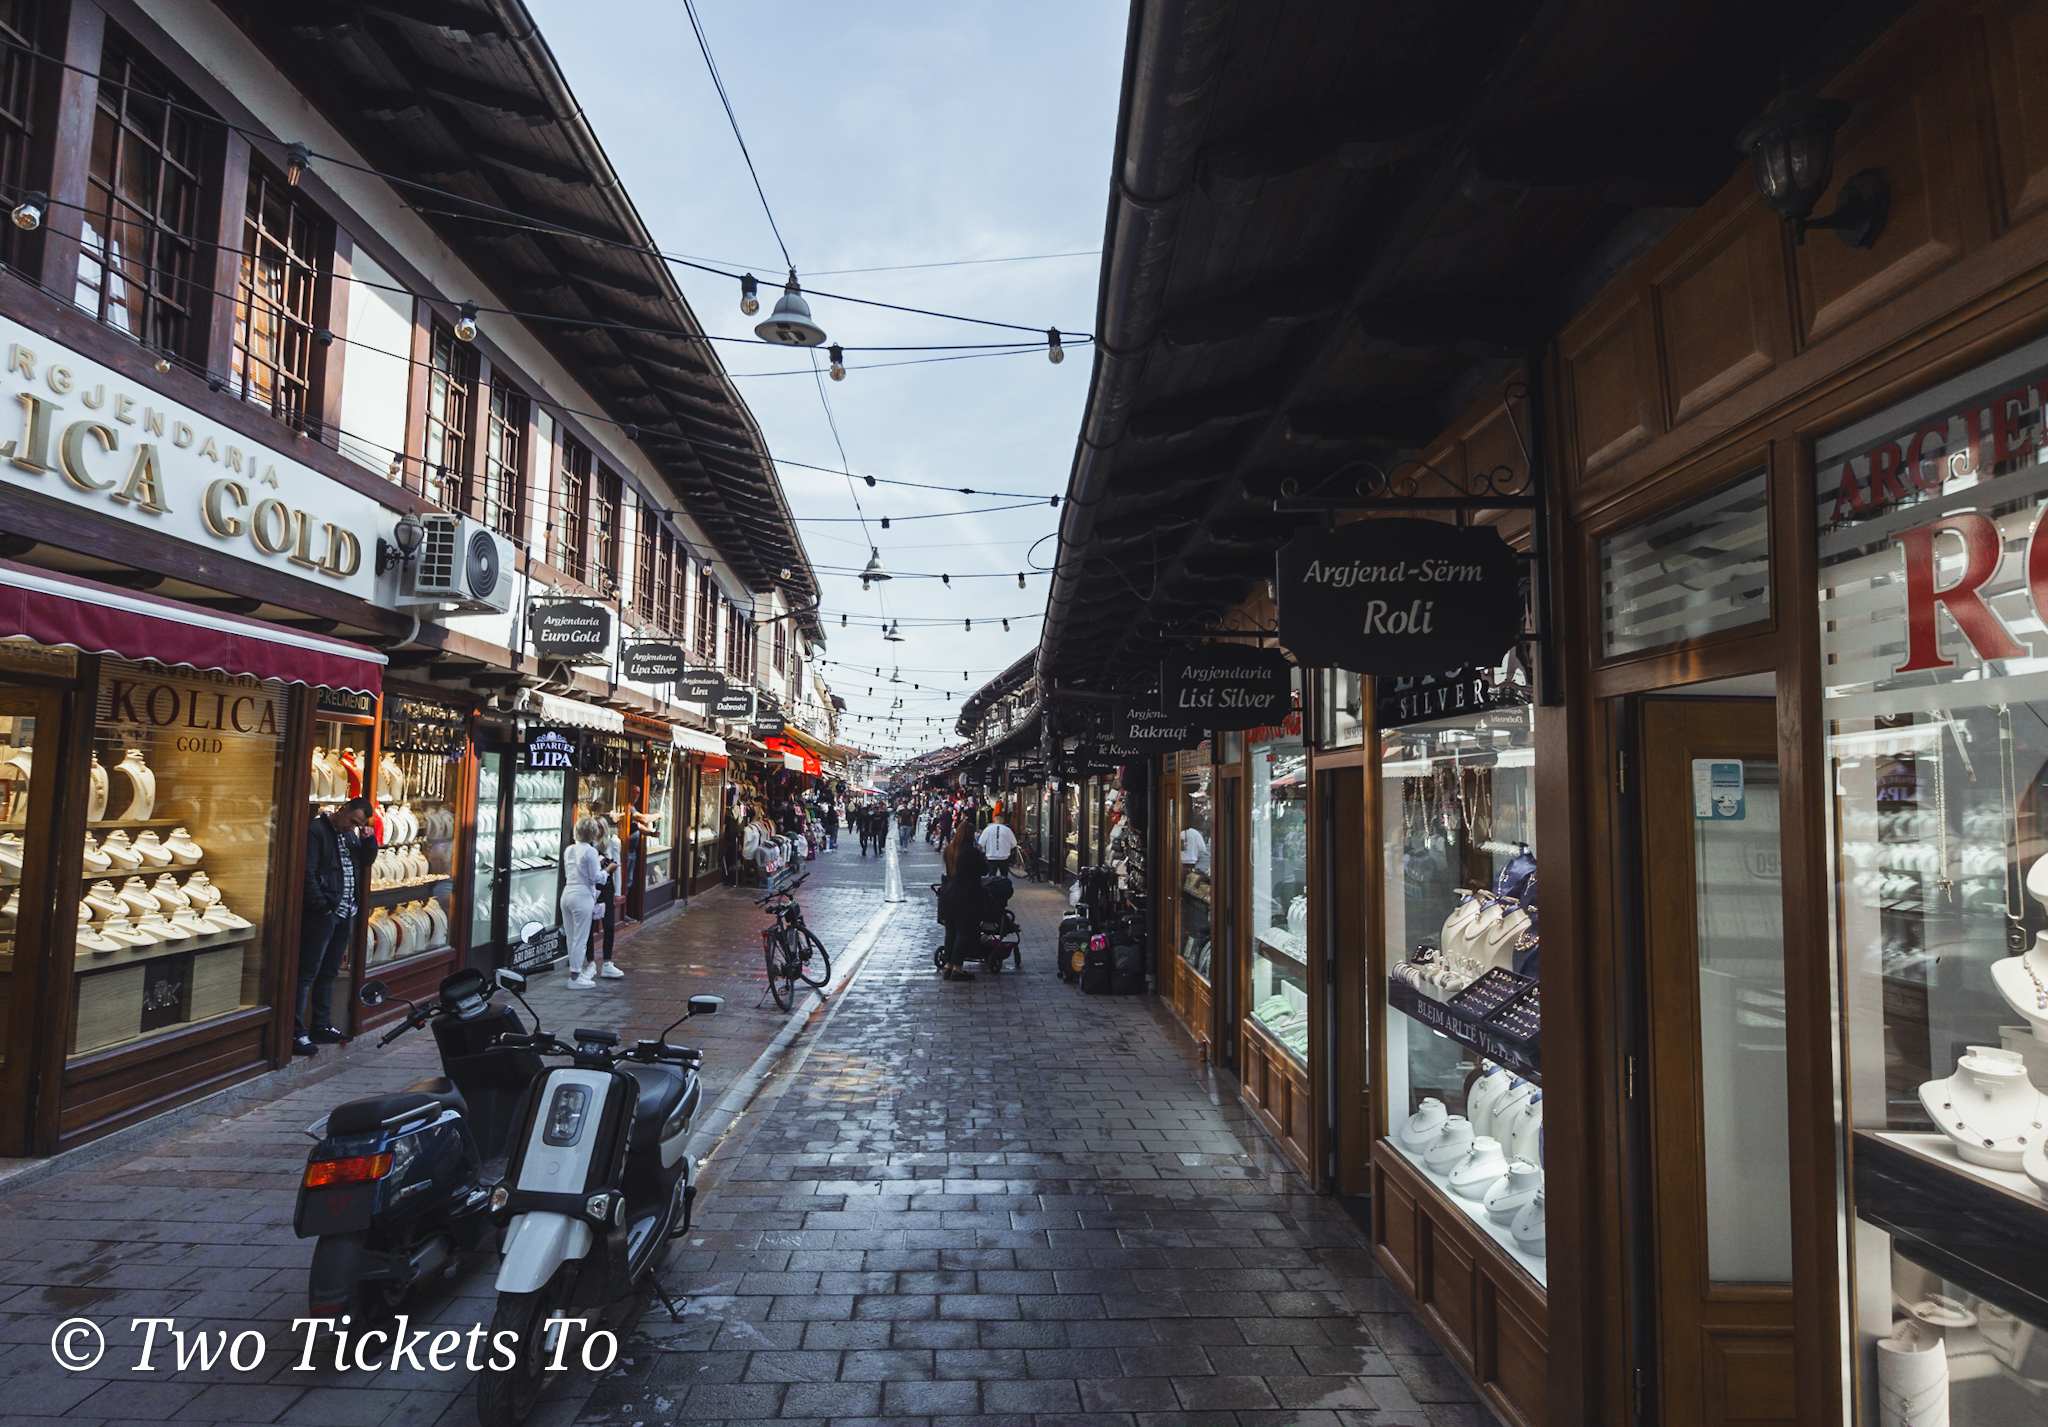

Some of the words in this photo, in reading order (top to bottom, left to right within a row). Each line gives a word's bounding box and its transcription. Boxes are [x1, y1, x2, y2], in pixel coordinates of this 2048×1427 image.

[0, 343, 280, 490] RGJENDARIA
[1829, 378, 2048, 521] ARGJE
[0, 391, 173, 515] ICA
[202, 478, 361, 578] GOLD
[1303, 559, 1483, 589] Argjend-Sërm
[1889, 503, 2048, 673] R
[543, 616, 600, 628] Argjendaria
[1362, 600, 1433, 635] Roli
[541, 630, 571, 643] Euro
[571, 630, 600, 643] Gold
[633, 653, 677, 663] Argjendaria
[630, 664, 651, 676] Lipa
[651, 664, 678, 675] Silver
[1181, 665, 1272, 683] Argjendaria
[108, 679, 280, 735] KOLICA
[1179, 687, 1213, 708] Lisi
[1218, 687, 1276, 708] Silver
[1399, 678, 1485, 720] SILVER
[1128, 726, 1188, 742] Bakraqi
[176, 736, 223, 754] GOLD
[529, 742, 575, 753] RIPARUES
[531, 752, 573, 768] LIPA
[1417, 999, 1445, 1026] BLEJM
